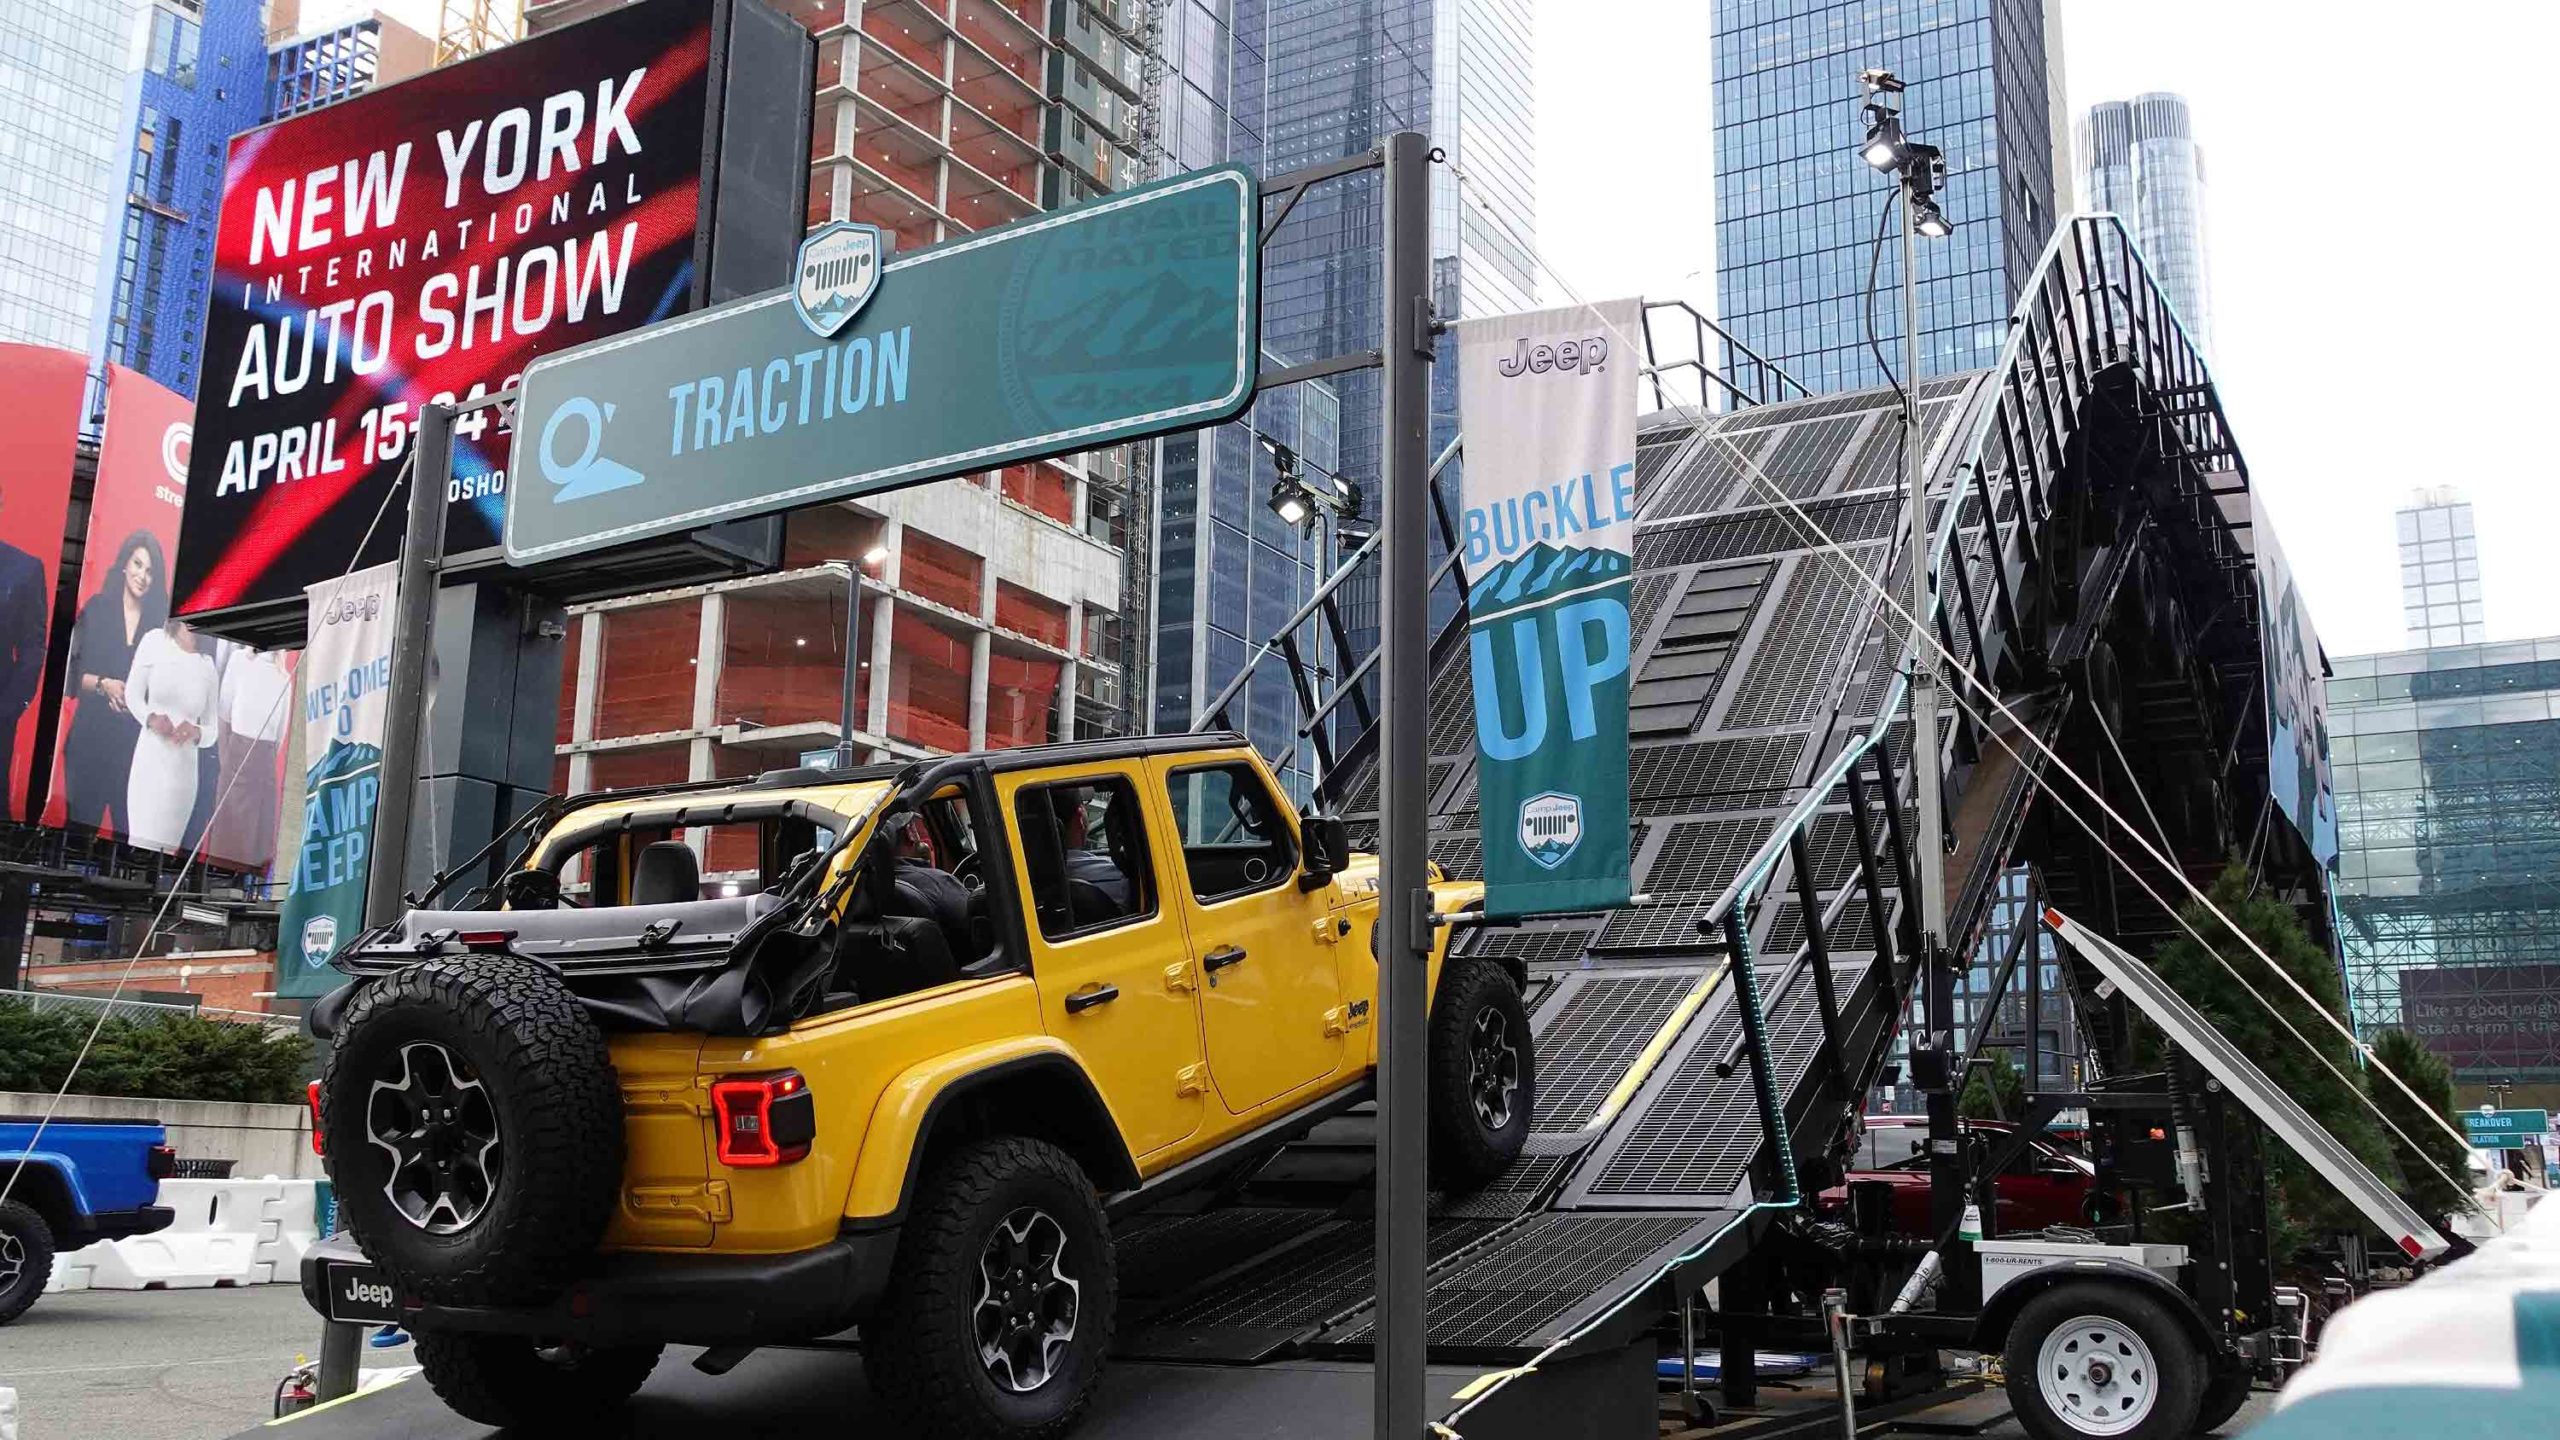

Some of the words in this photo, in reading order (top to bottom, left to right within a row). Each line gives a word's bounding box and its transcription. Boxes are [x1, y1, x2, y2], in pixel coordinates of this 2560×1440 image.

[249, 143, 412, 265] NEW
[437, 68, 648, 208] YORK
[243, 173, 643, 310] INTERNATIONAL
[843, 238, 870, 251] Jeep
[228, 290, 395, 407] AUTO
[415, 222, 639, 359] SHOW
[1499, 336, 1608, 378] Jeep
[669, 325, 912, 457] TRACTION
[215, 423, 346, 497] APRIL
[360, 382, 488, 468] 15-4
[155, 485, 184, 508] stre
[1464, 462, 1635, 566] BUCKLE
[326, 593, 381, 625] Jeep
[1471, 598, 1630, 761] UP
[305, 776, 378, 839] AMP
[2416, 1002, 2449, 1018] Like
[2468, 1003, 2508, 1019] good
[2511, 1001, 2560, 1019] neigh
[2417, 1023, 2461, 1035] Stae
[346, 1277, 394, 1308] Jeep
